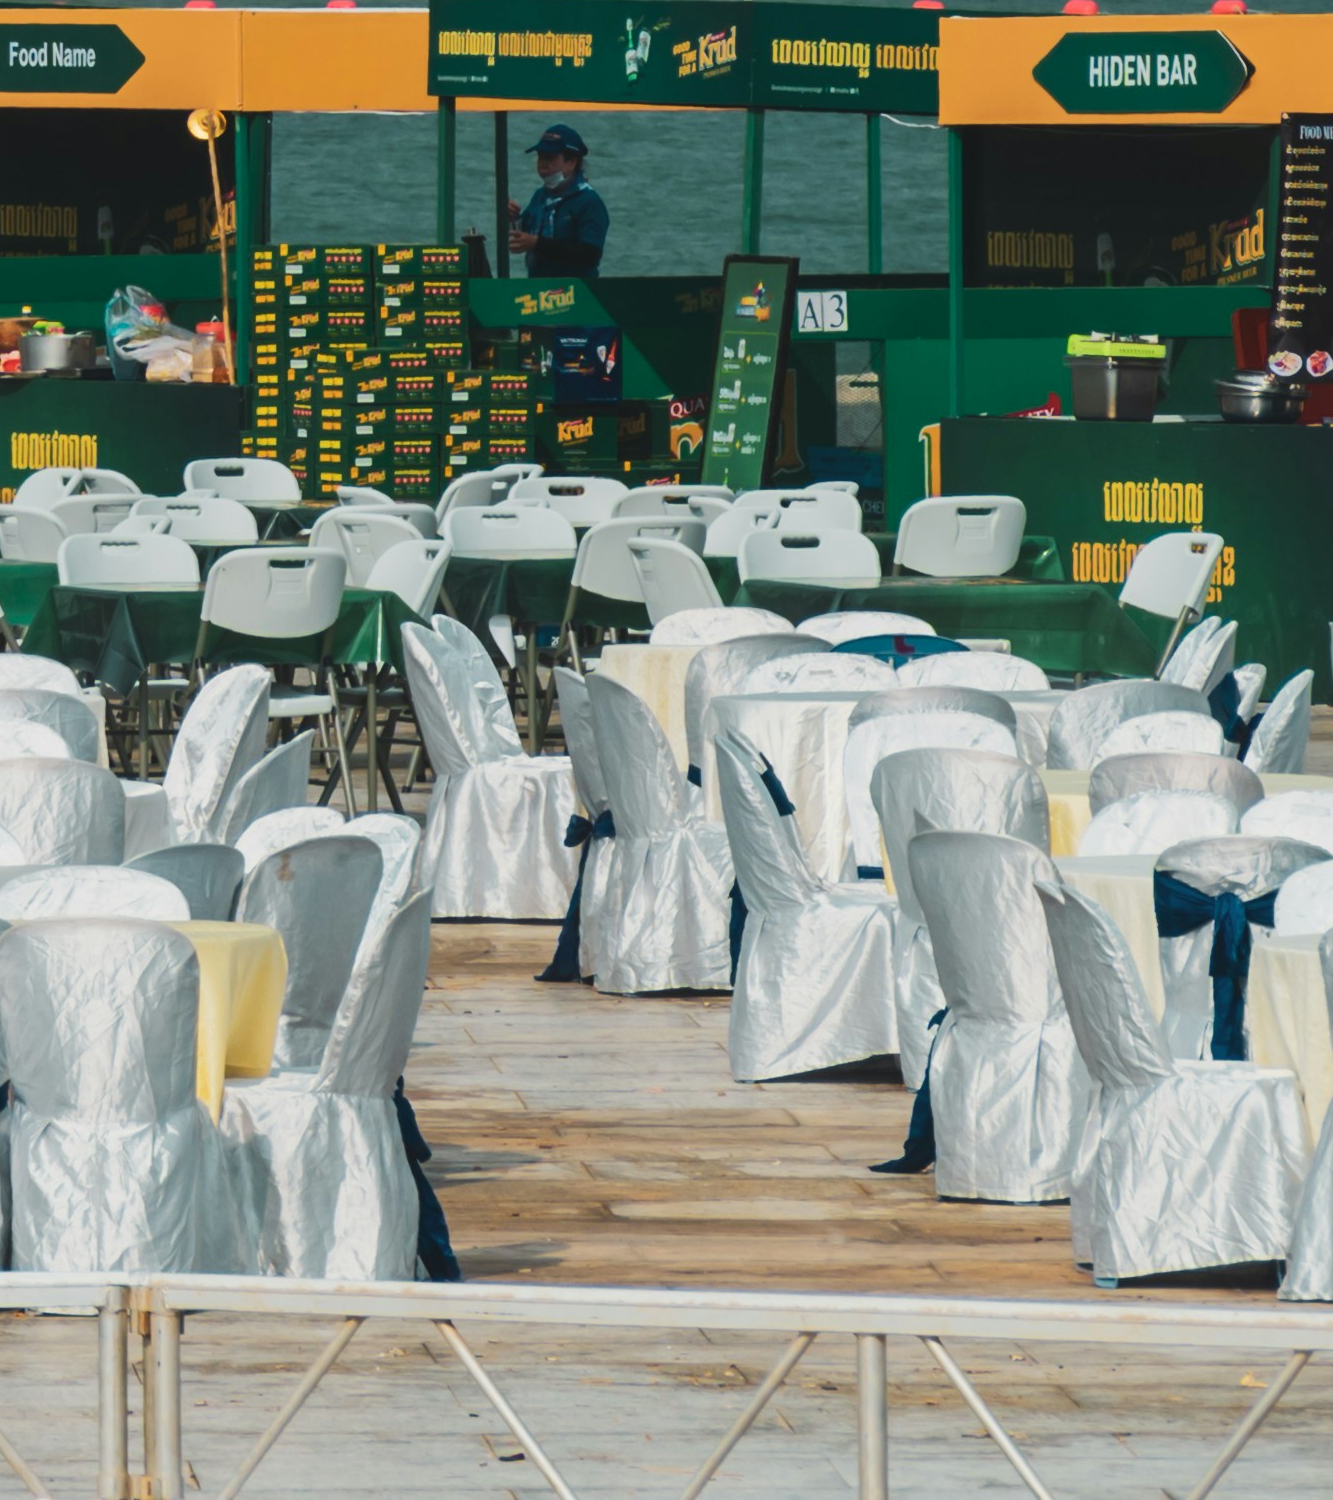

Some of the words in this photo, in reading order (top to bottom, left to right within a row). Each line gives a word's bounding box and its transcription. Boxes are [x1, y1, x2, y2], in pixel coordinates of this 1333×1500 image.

[9, 41, 48, 68] Food
[52, 42, 96, 68] Name
[699, 25, 738, 72] Krud
[1088, 54, 1151, 88] HIDEN
[1156, 53, 1198, 87] BAR
[1299, 125, 1323, 140] FOOD
[1208, 208, 1266, 276] Krud
[557, 416, 594, 444] Krud
